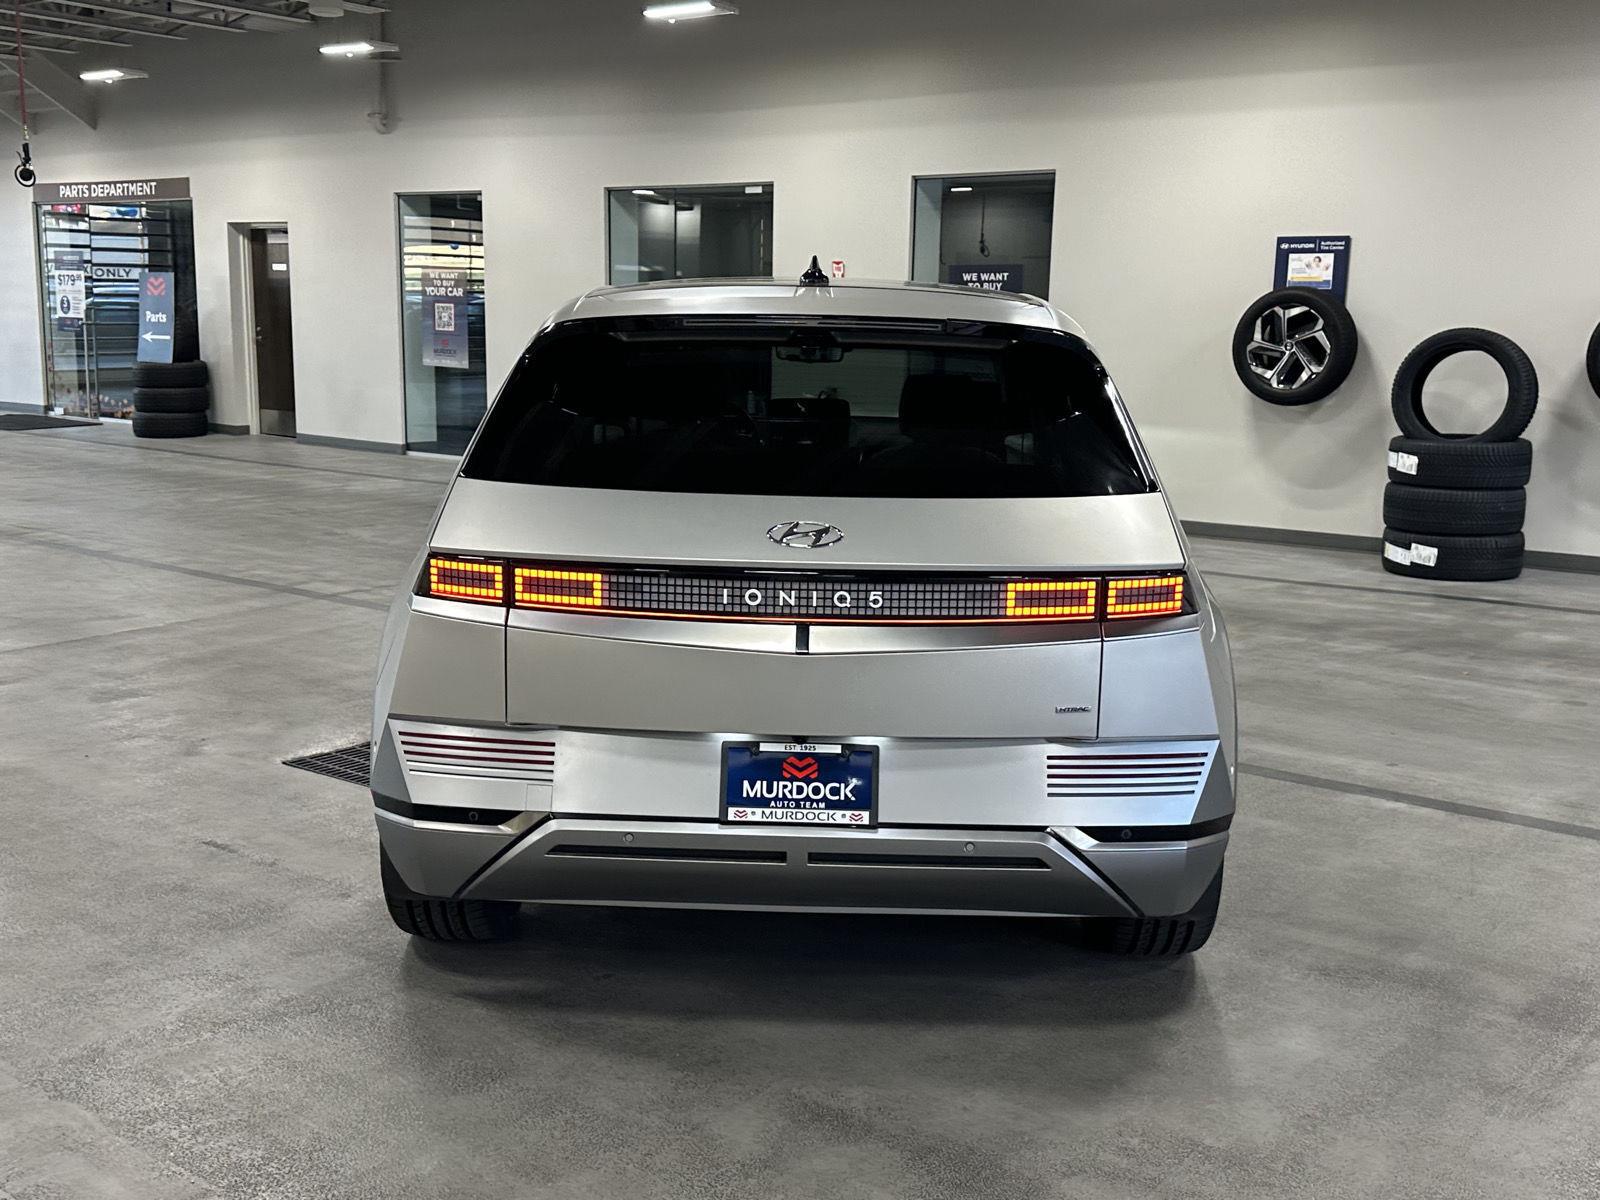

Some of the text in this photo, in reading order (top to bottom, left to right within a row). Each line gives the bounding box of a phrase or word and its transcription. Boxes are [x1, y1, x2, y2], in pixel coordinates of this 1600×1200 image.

[59, 182, 157, 198] PARTS DEPARTMENT
[94, 268, 132, 278] ONLY
[430, 271, 459, 279] WE WANT
[962, 272, 1009, 281] WE WANT
[433, 279, 441, 287] TO
[982, 282, 1003, 291] BUY
[425, 286, 464, 297] YOUR CAR
[145, 310, 167, 323] Parts
[723, 588, 851, 608] IONIQ
[742, 779, 857, 801] MURDOCK
[769, 800, 826, 809] AUTO TEAM
[761, 810, 837, 822] MURDOCK
